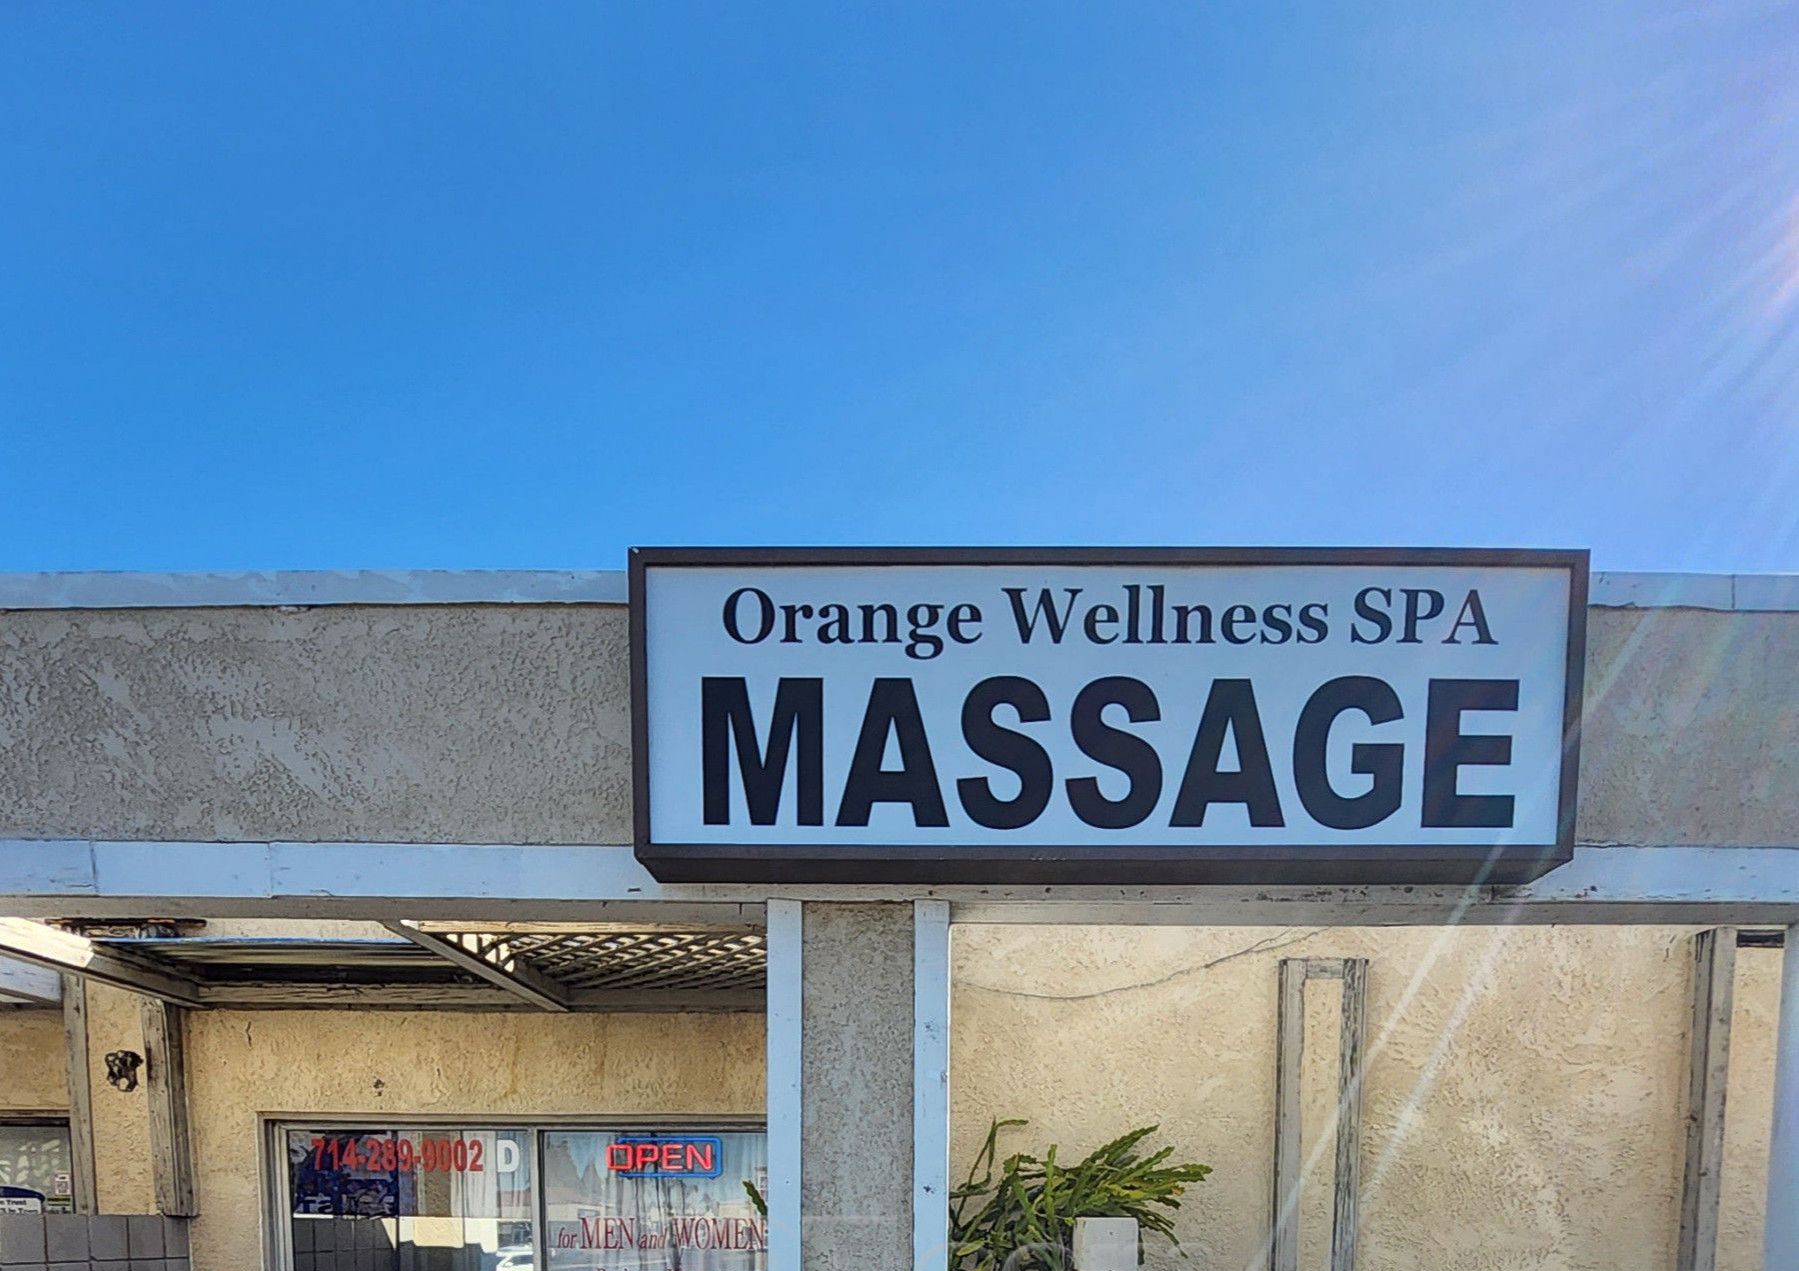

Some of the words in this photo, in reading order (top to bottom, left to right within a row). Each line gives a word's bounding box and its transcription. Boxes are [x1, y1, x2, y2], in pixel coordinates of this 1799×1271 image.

[722, 586, 982, 660] Orange
[1001, 583, 1328, 646] Wellness
[1351, 586, 1499, 646] SPA
[700, 675, 1520, 831] MASSAGE
[311, 1138, 484, 1172] 714-289-9002
[496, 1139, 521, 1173] D
[604, 1143, 713, 1171] OPEN
[557, 1226, 578, 1249] for
[579, 1216, 636, 1250] MEN
[638, 1226, 668, 1250] and
[671, 1216, 768, 1250] WOMEN
